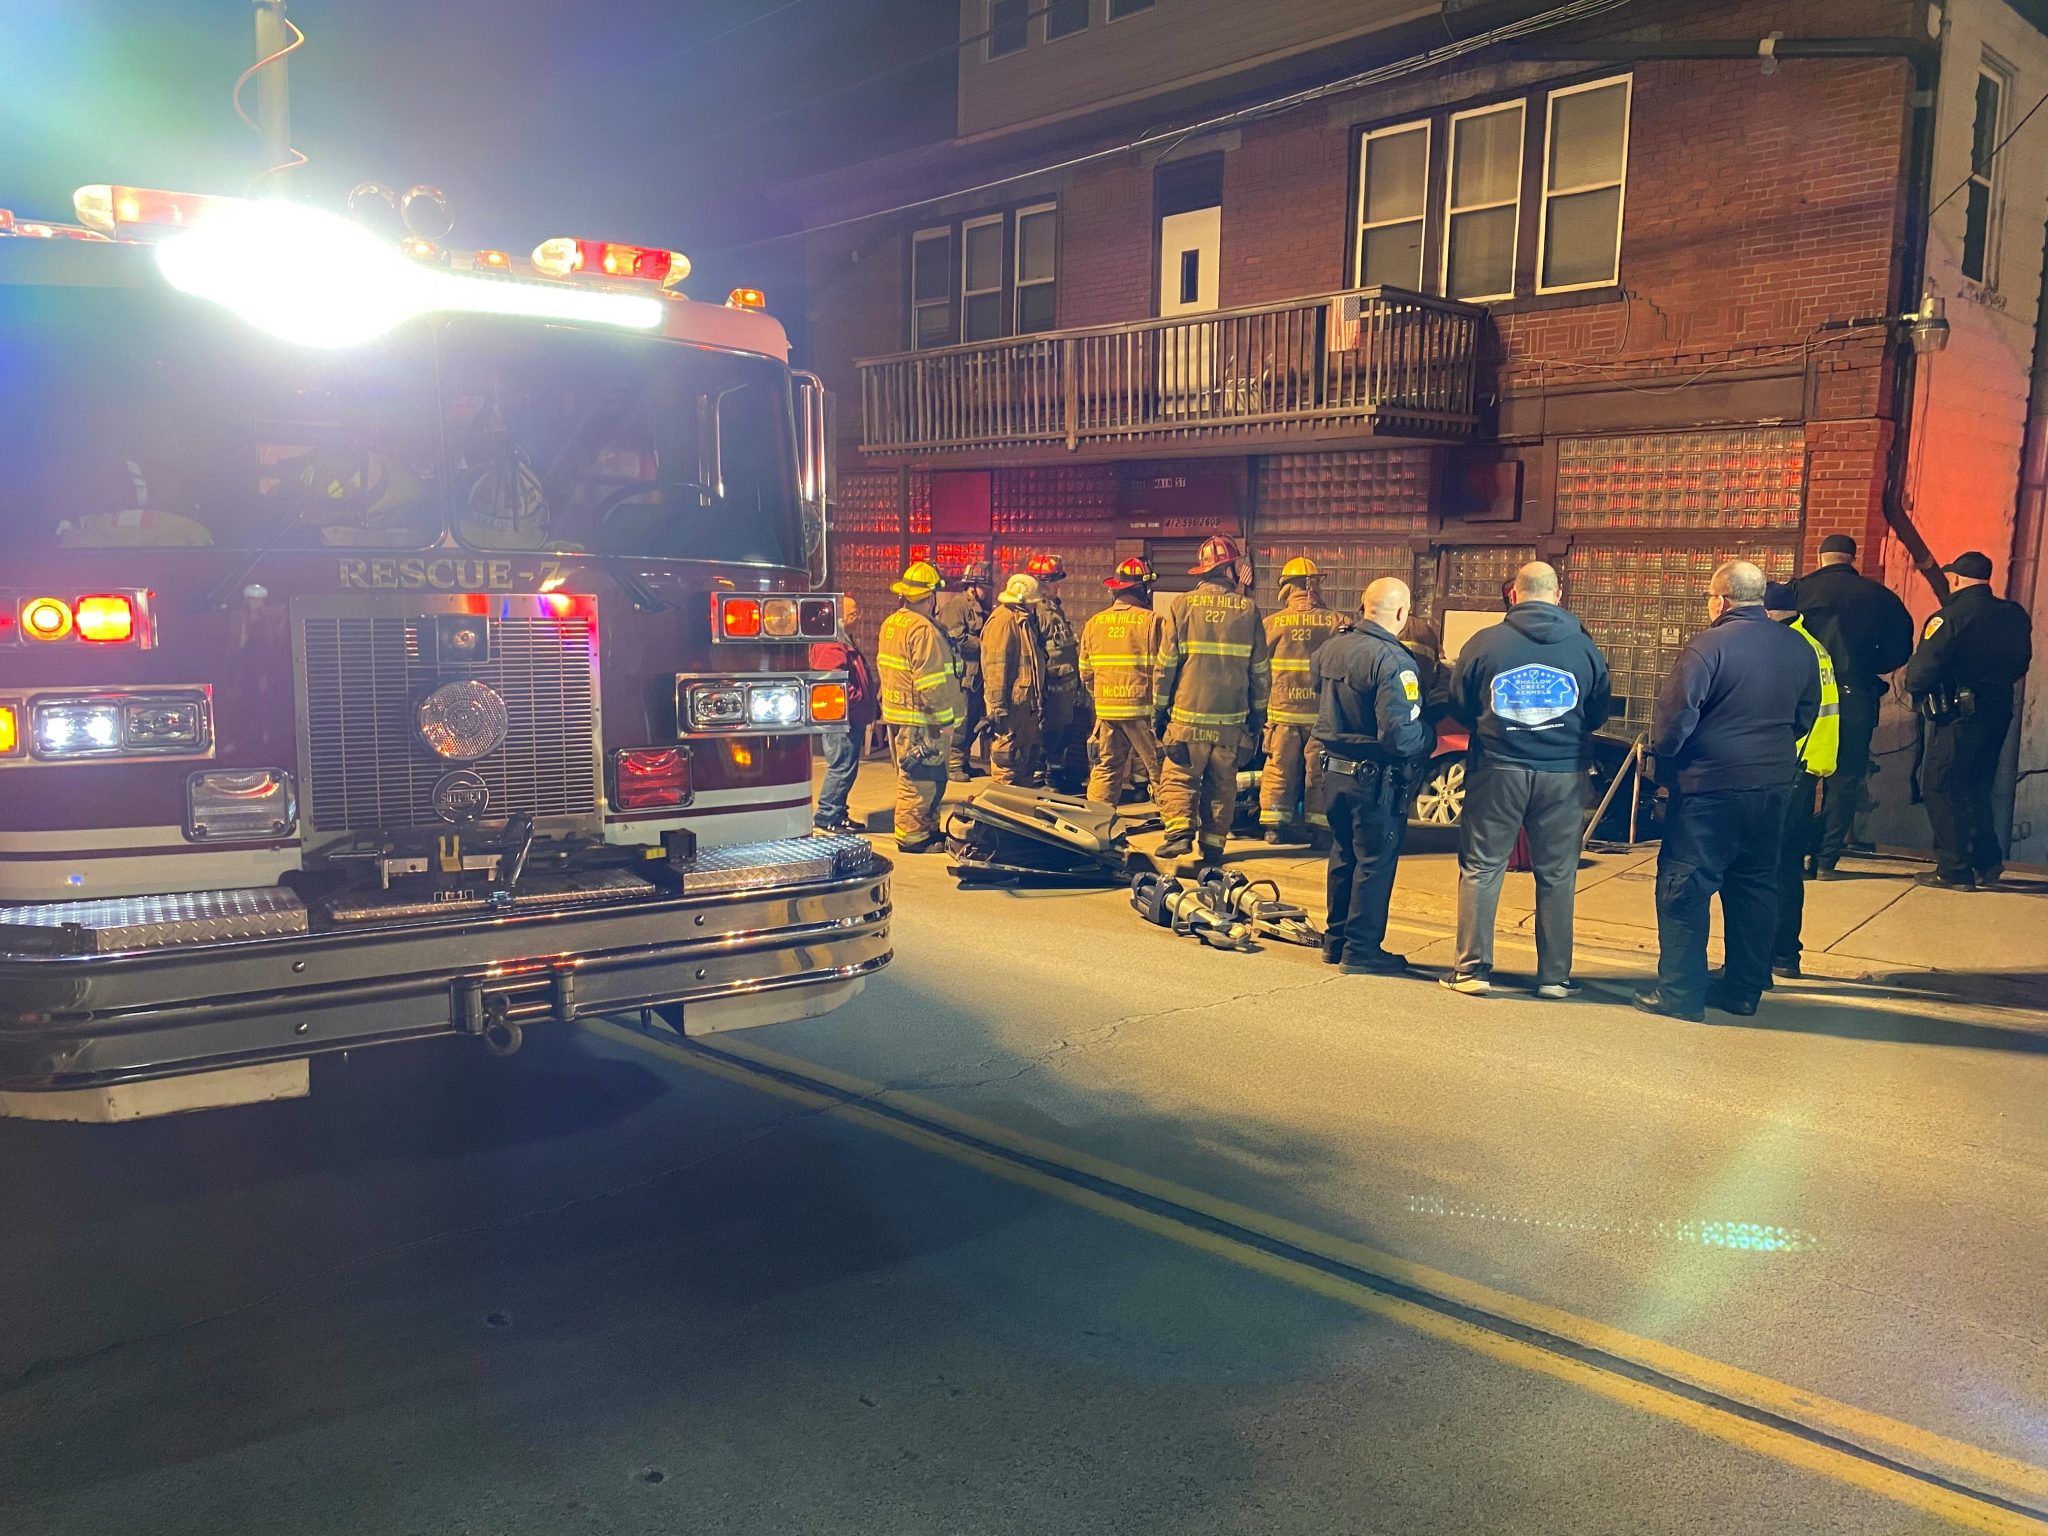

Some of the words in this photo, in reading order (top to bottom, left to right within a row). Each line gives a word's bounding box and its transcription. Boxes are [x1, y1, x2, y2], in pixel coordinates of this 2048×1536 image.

[1186, 595, 1214, 608] PENN
[1217, 595, 1248, 610] HILLS
[1094, 612, 1117, 625] PENN
[1117, 612, 1145, 625] HILLS
[1205, 610, 1227, 623] 227
[1274, 614, 1299, 628] PENN
[1302, 614, 1332, 627] HILLS
[1107, 626, 1125, 638] 223
[1291, 628, 1312, 641] 223
[1102, 685, 1133, 698] McCOY
[1191, 727, 1219, 743] LONG
[440, 790, 481, 804] SUTPHEN
